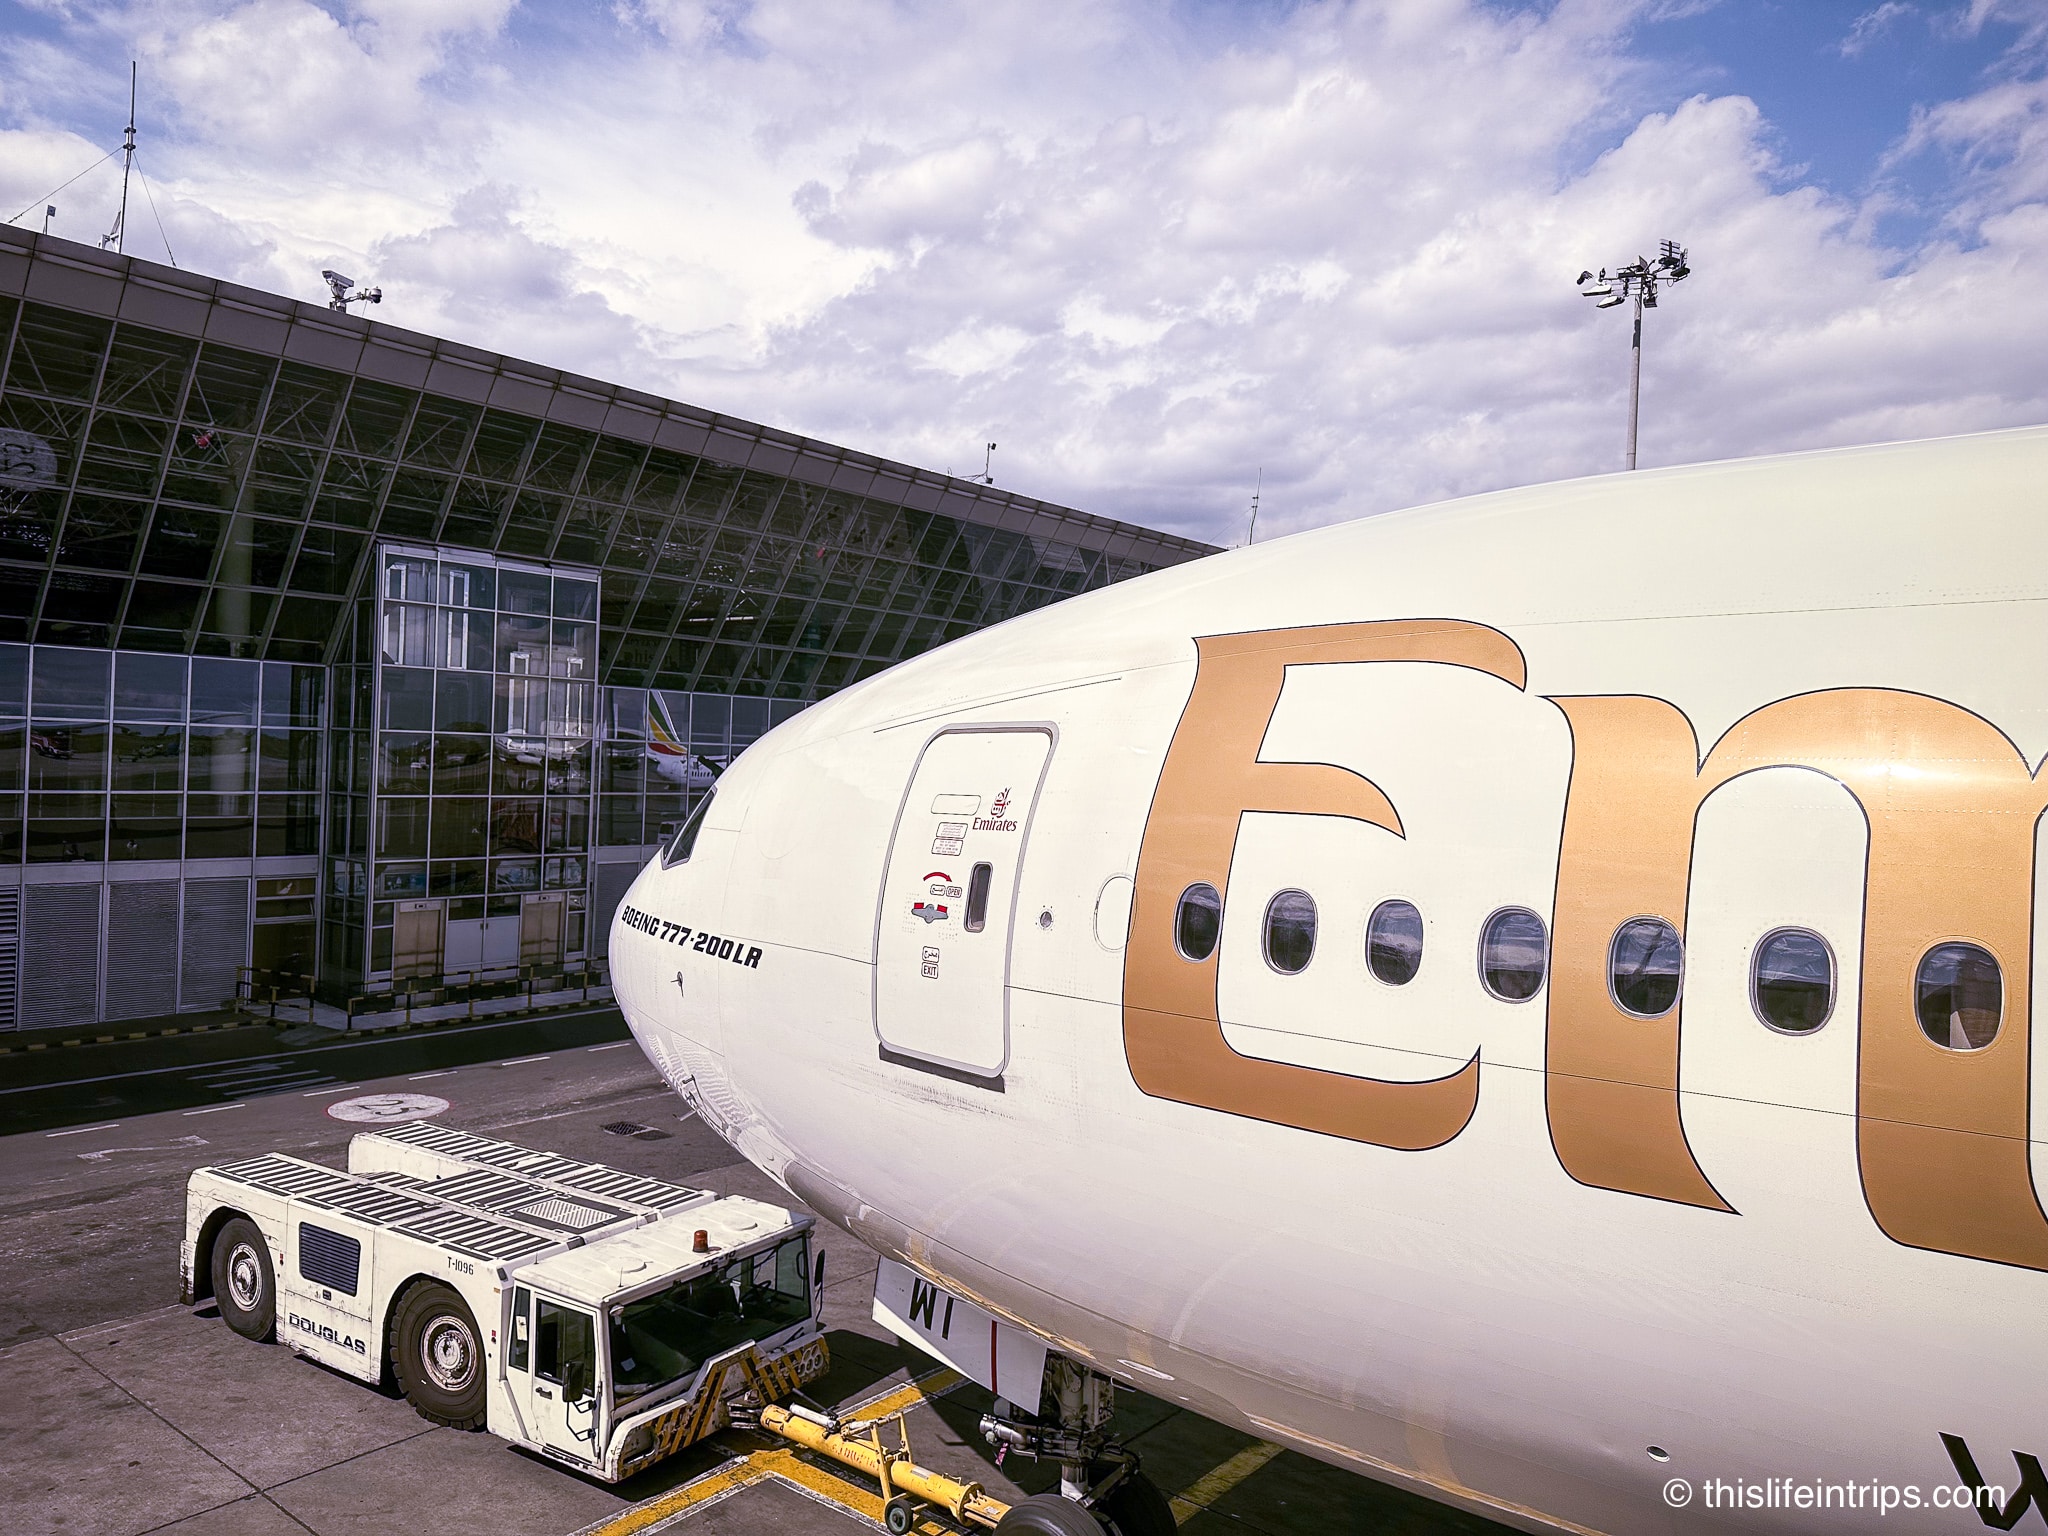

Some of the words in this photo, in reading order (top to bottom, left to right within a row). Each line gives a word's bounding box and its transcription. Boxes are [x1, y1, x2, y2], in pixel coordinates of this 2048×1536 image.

[972, 817, 1018, 832] Emirates
[947, 888, 960, 897] OPEN
[622, 905, 660, 936] BOEING
[923, 965, 937, 976] EXIT
[289, 1312, 366, 1355] DOUGLAS
